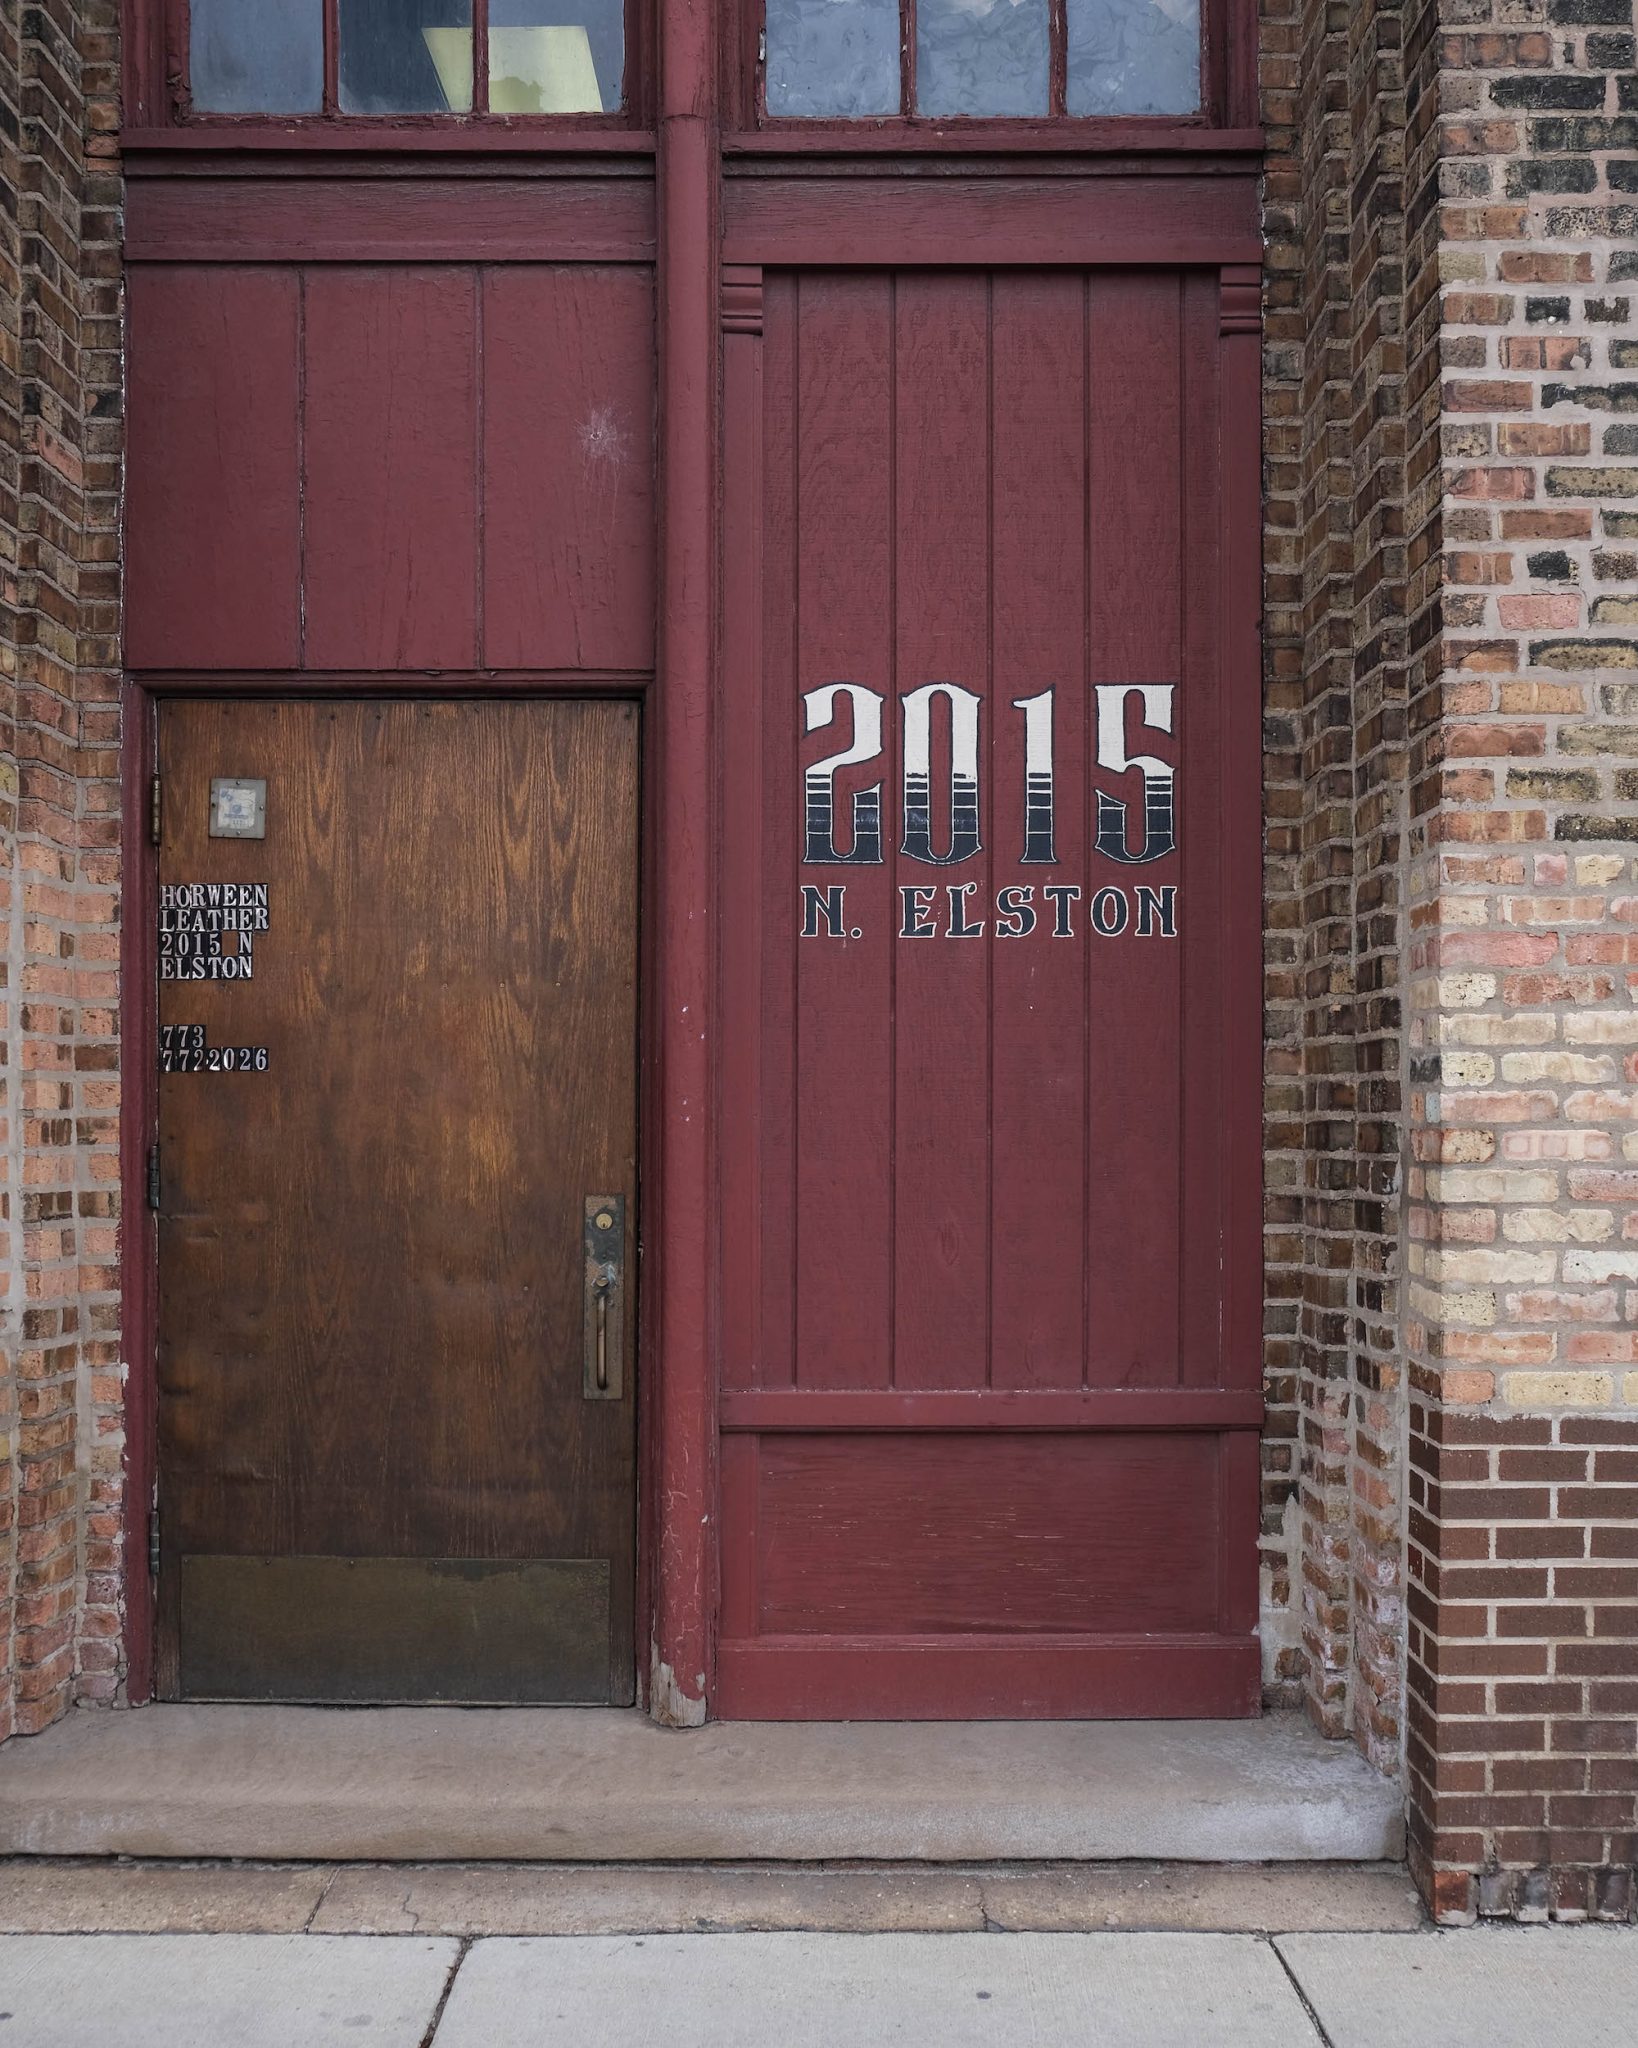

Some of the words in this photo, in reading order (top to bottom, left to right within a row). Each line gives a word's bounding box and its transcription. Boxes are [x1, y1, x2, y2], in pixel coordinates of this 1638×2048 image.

[801, 681, 1178, 865] 2015
[160, 884, 268, 908] HORWEEN
[160, 908, 269, 932] LEATHER
[800, 885, 862, 938] N.
[898, 883, 1178, 939] ELSTON
[161, 932, 221, 955] 2015
[239, 932, 252, 954] N
[160, 956, 252, 980] ELSTON
[162, 1025, 204, 1048] 773
[162, 1048, 268, 1071] 7722026
